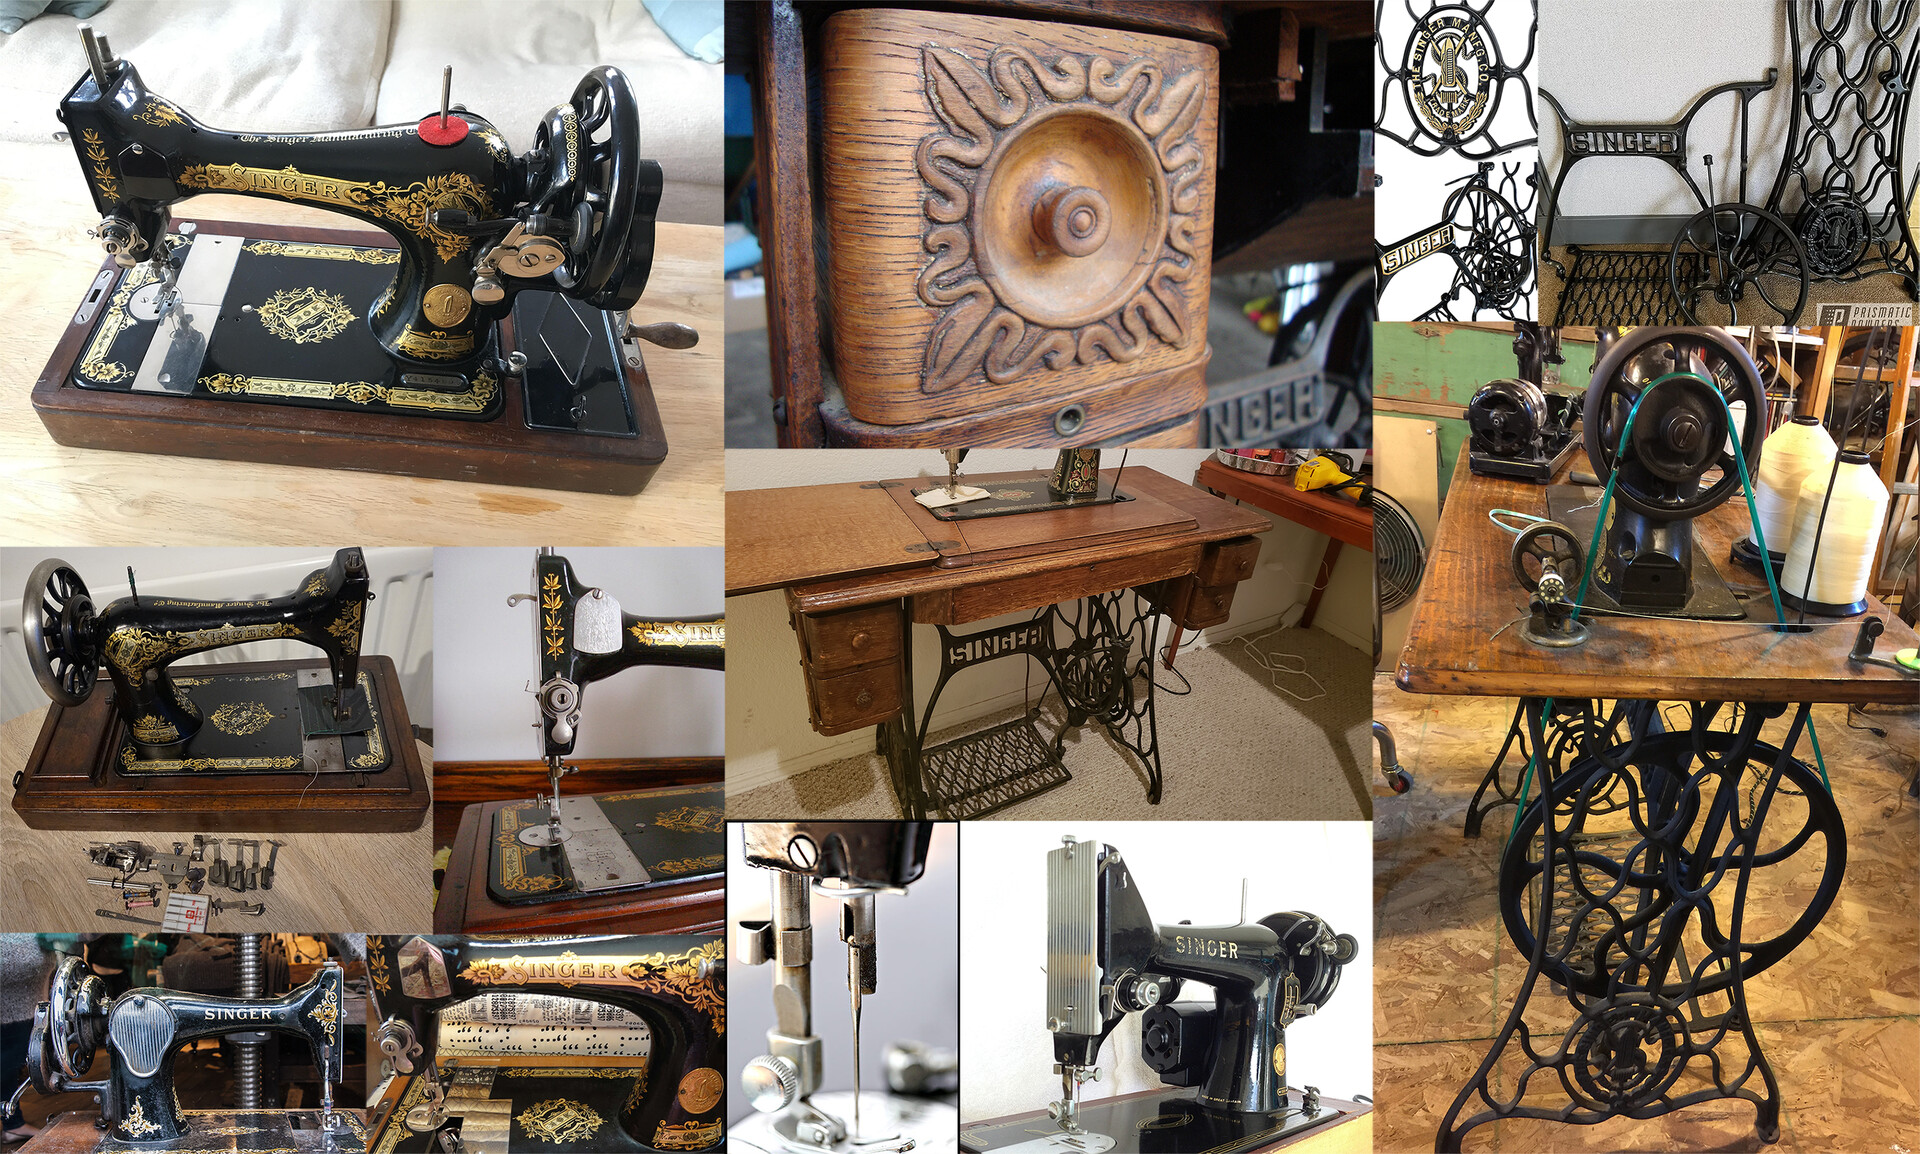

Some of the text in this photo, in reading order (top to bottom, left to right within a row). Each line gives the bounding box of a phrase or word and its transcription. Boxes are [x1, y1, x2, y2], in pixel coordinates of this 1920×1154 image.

[1414, 18, 1445, 61] SINGER
[1412, 66, 1421, 89] THE
[1429, 96, 1471, 118] TRADE MARK
[1572, 131, 1676, 153] SINGER
[228, 162, 341, 200] SINGER
[1384, 226, 1452, 273] SINGER
[196, 627, 272, 648] SINGER
[951, 626, 1042, 664] SINGER
[1175, 935, 1239, 959] SINGER
[508, 954, 618, 986] SINGER
[204, 1007, 272, 1020] SINGER
